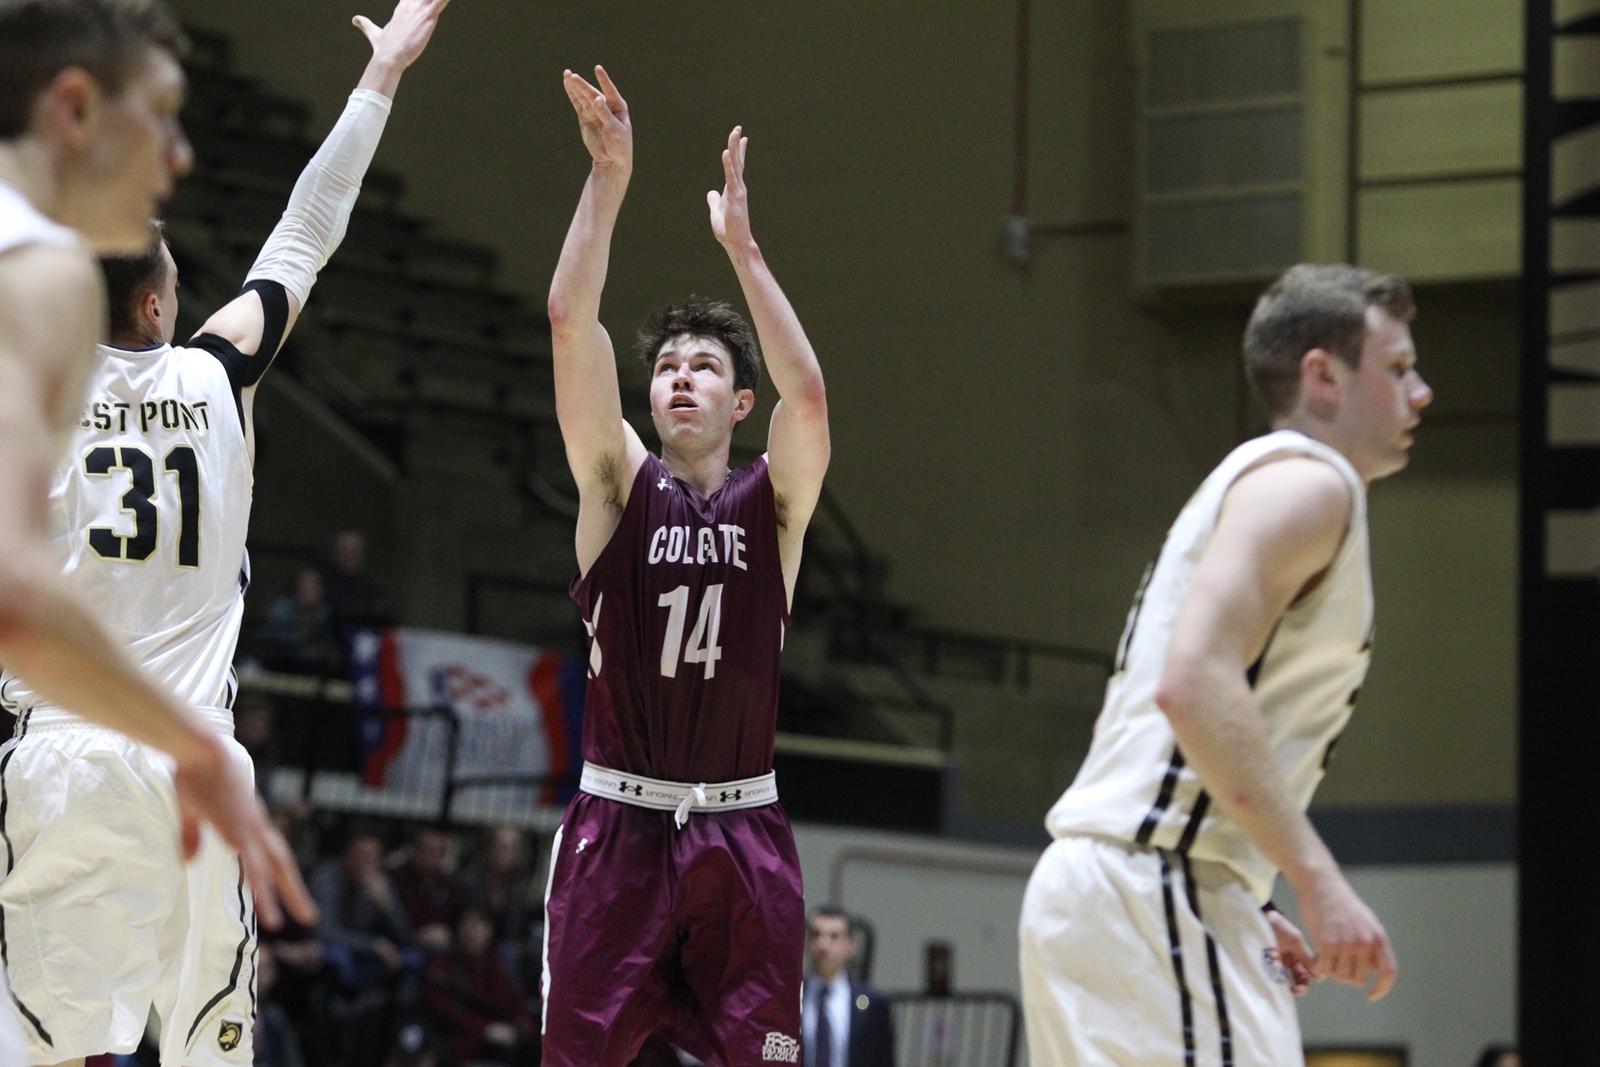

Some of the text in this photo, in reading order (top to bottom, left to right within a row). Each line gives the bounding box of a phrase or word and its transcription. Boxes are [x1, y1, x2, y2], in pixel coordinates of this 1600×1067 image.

[84, 446, 200, 568] 31
[648, 524, 748, 571] COLGATE
[658, 583, 724, 680] 14
